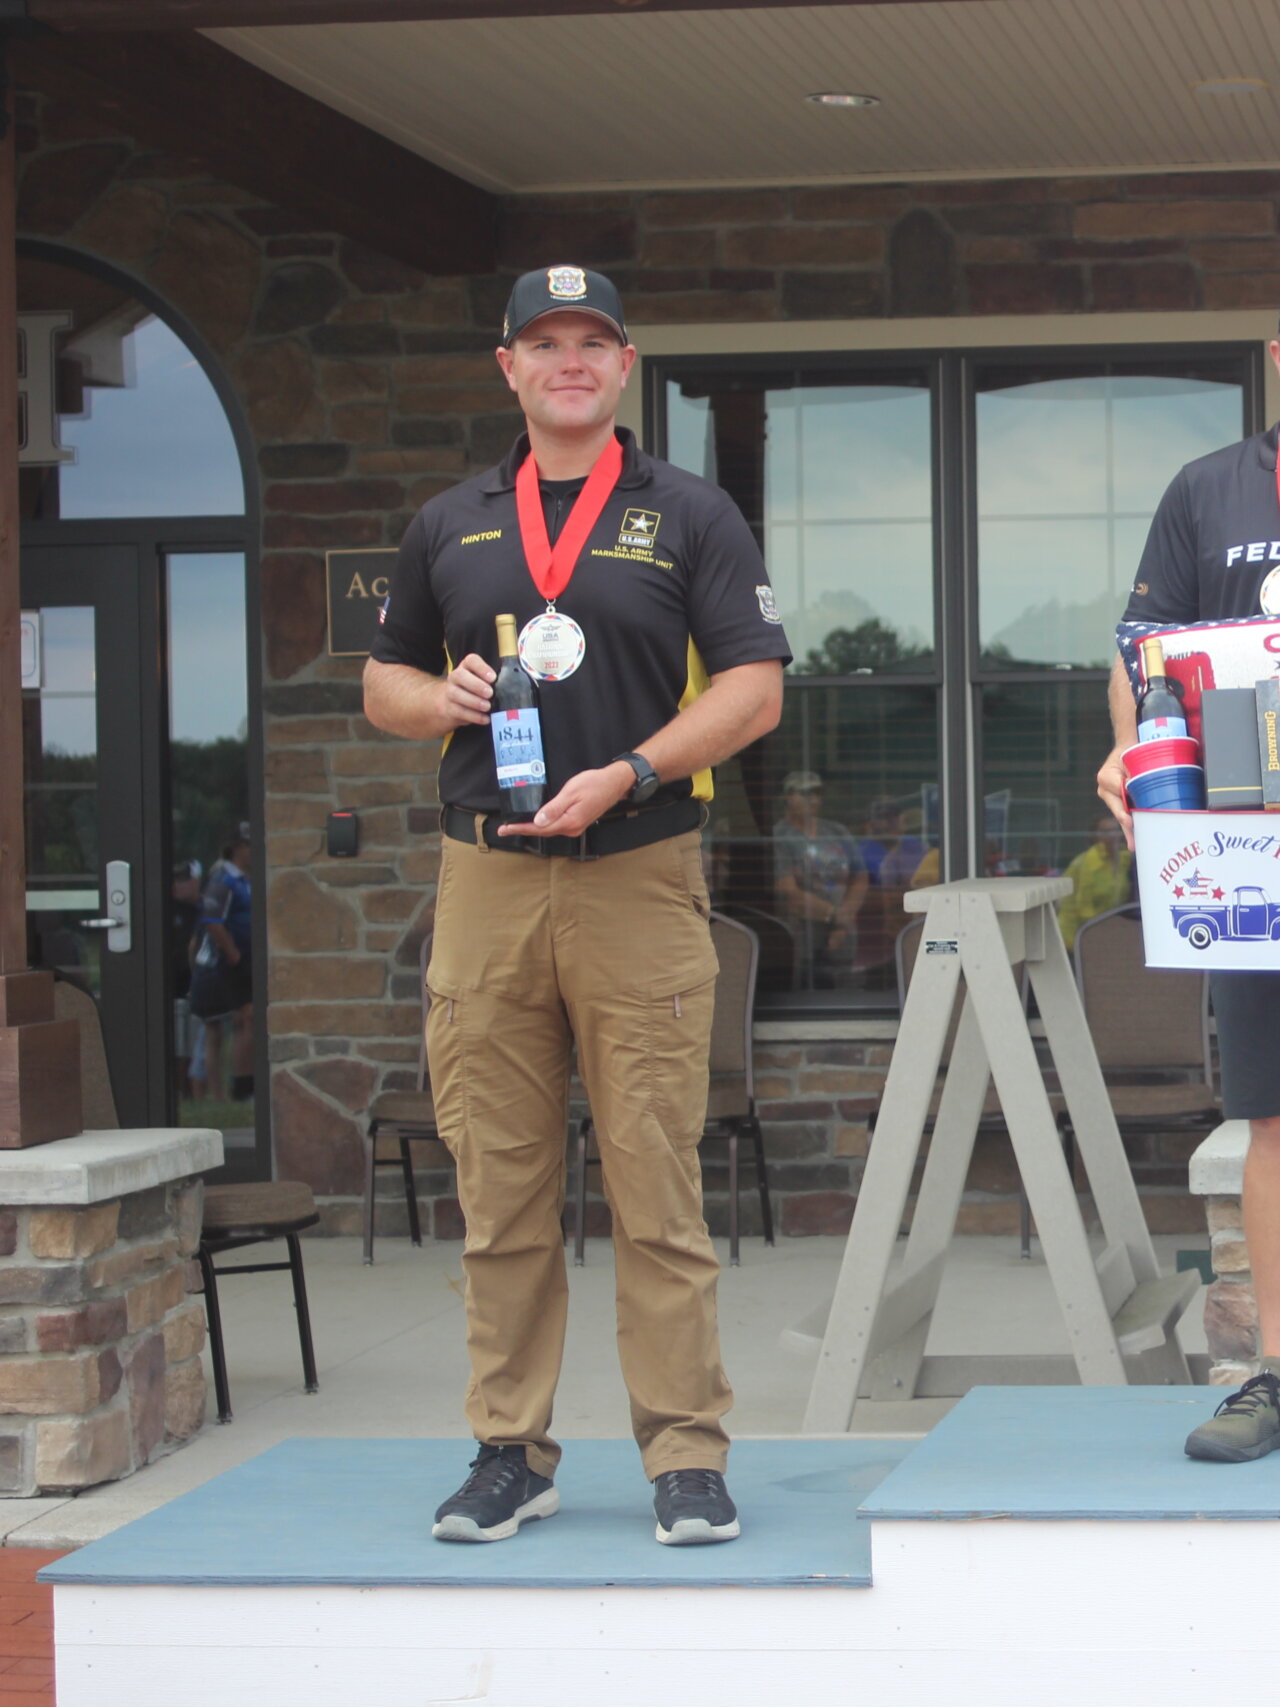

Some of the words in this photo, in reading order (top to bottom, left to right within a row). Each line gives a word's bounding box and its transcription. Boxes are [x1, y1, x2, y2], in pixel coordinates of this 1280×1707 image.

[461, 529, 502, 545] HINTON
[591, 548, 655, 563] MARKSMANSHIP
[655, 559, 674, 570] UNIT
[630, 547, 654, 557] ARMY
[498, 726, 534, 742] 1844
[1264, 711, 1280, 771] BROWNING
[1160, 840, 1204, 885] HOME
[1207, 831, 1280, 857] Sweet
